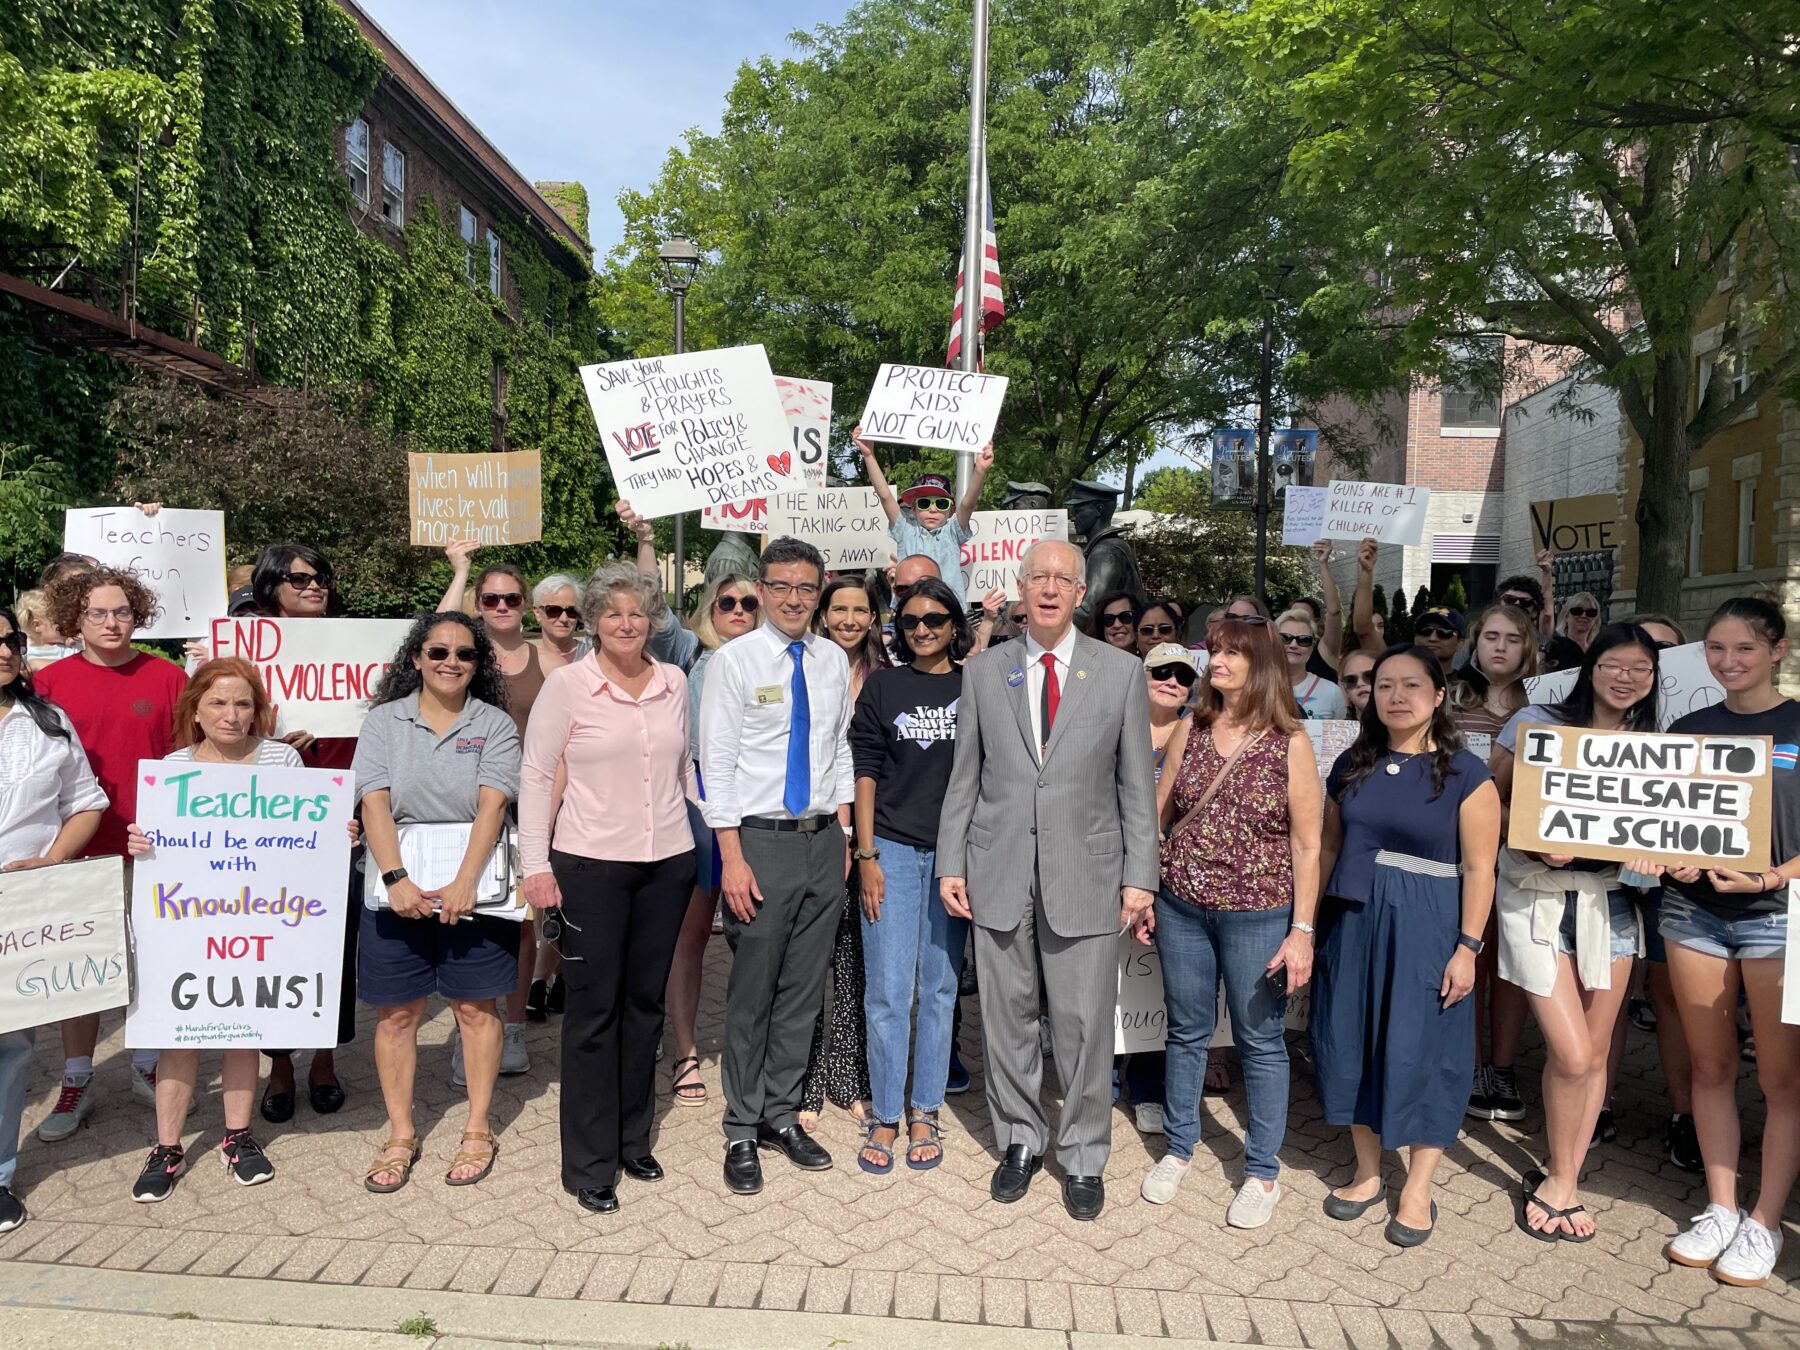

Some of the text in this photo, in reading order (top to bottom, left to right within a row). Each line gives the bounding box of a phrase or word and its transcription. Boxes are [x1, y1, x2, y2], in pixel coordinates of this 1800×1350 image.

[596, 366, 635, 392] SAVE
[633, 368, 723, 399] THOUGHTS
[885, 365, 997, 394] PROTECT
[641, 387, 733, 421] & PRAYERS
[910, 391, 962, 413] KIDS
[612, 421, 662, 457] VOTE
[658, 420, 679, 440] FOR
[681, 414, 737, 447] POLICY
[866, 411, 981, 445] NOT GUNS
[674, 434, 753, 466] CHANGE
[623, 470, 660, 490] THEY
[659, 468, 682, 483] HAD
[686, 459, 744, 490] HOPES
[706, 471, 778, 505] DREAMS
[417, 489, 455, 519] lives
[458, 494, 476, 519] be
[777, 491, 880, 511] THE NRA IS
[1333, 483, 1366, 497] GUNS
[1371, 485, 1389, 498] ARE
[1330, 499, 1374, 515] KILLER
[1382, 505, 1400, 516] OF
[90, 512, 211, 552] Teachers
[417, 519, 460, 545] more
[463, 519, 499, 545] than
[787, 516, 881, 534] TAKING OUR
[994, 514, 1059, 535] MORE
[1327, 519, 1383, 535] CHILDREN
[839, 547, 878, 564] AWAY
[975, 567, 1006, 590] GUN
[212, 618, 282, 662] END
[275, 663, 389, 702] VIOLENC
[906, 713, 951, 729] Save
[914, 705, 957, 719] Vote
[896, 723, 957, 742] Ameri
[1527, 732, 1555, 763] I
[1583, 738, 1695, 770] WANT
[1704, 743, 1756, 774] TO
[164, 770, 331, 822] Teachers
[224, 830, 248, 850] be
[255, 831, 318, 850] armed
[1543, 809, 1745, 856] AT SCHOOL
[210, 856, 257, 872] with
[153, 882, 328, 927] Knowledge
[206, 936, 274, 962] NOT
[16, 952, 123, 1000] GUNS
[171, 972, 324, 1018] GUNS!
